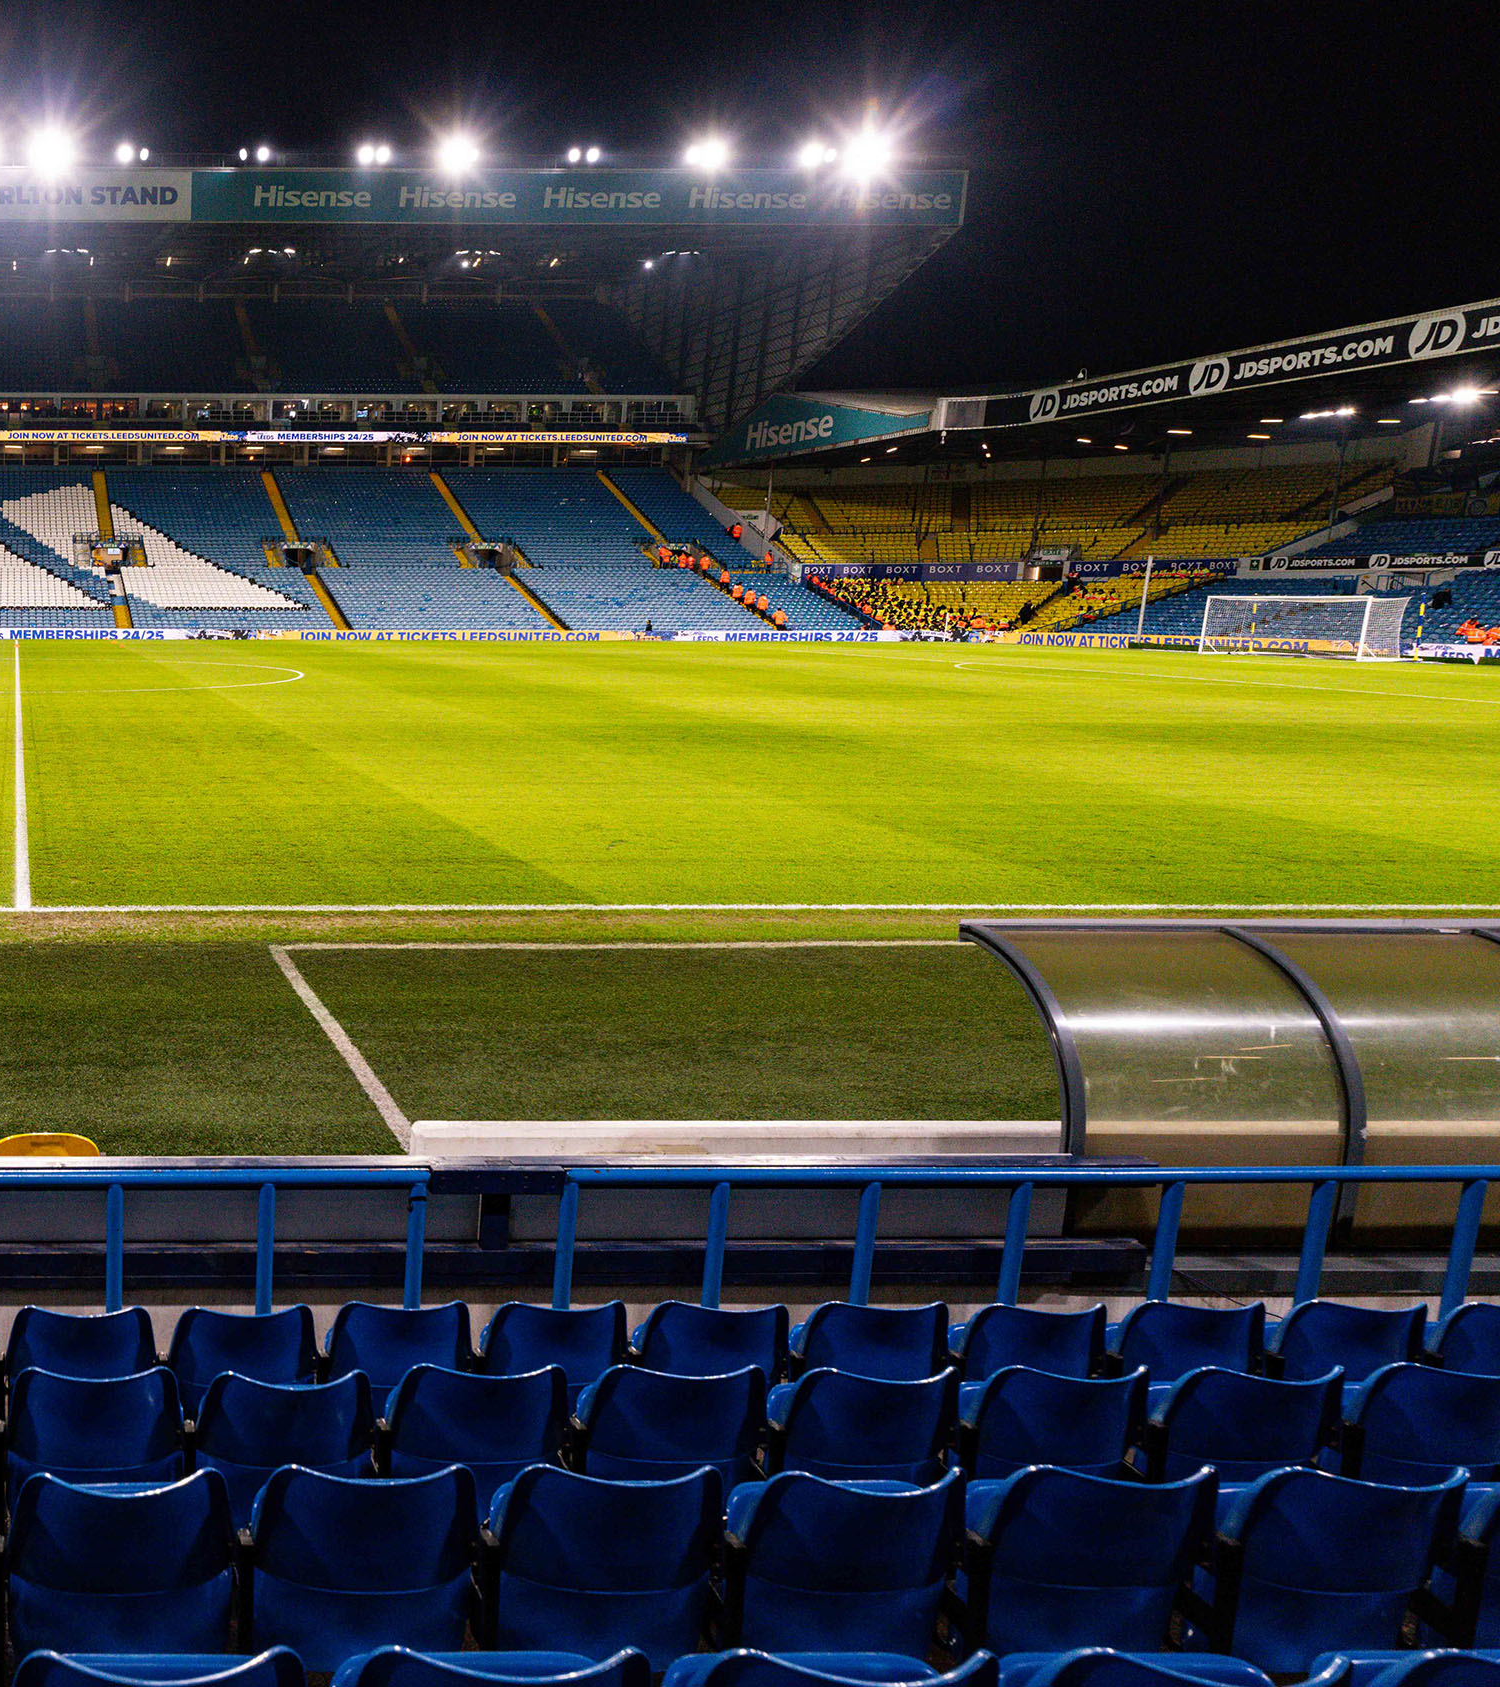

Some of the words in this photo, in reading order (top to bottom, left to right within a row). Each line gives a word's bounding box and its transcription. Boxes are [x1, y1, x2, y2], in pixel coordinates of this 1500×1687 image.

[91, 185, 179, 206] STAND
[253, 185, 372, 208] Hisense
[399, 186, 517, 209] Hisense
[544, 187, 661, 209] Hisense
[688, 187, 806, 209] Hisense
[1062, 374, 1178, 411] JDSPORTS.COM
[1233, 336, 1394, 381] JDSPORTS.COM
[8, 432, 30, 441] JOIN
[32, 432, 54, 440] NOW
[57, 432, 69, 440] AT
[70, 432, 200, 441] TICKETS.LEEDSUNITED.COM
[277, 432, 346, 441] MEMBERSHIPS
[347, 432, 375, 441] 24/25
[746, 413, 834, 450] Hisense
[457, 433, 478, 442] JOIN
[481, 433, 503, 442] NOW
[506, 433, 519, 442] AT
[520, 433, 648, 443] TICKETS.LEEDSUNITED.COM
[1075, 563, 1110, 572] BOXT
[1209, 561, 1239, 570] BOXT
[1290, 557, 1356, 567] JDSPORTS.COM
[1392, 555, 1468, 565] JDSPORTS.COM
[804, 566, 833, 575] BOXT
[843, 565, 873, 575] BOXT
[886, 565, 918, 575] BOXT
[929, 564, 962, 574] BOXT
[976, 564, 1011, 574] BOXT
[9, 630, 118, 640] MEMBERSHIPS
[122, 630, 165, 640] 24/25
[300, 632, 332, 641] JOIN
[336, 632, 372, 641] NOW
[376, 632, 394, 641] AT
[725, 632, 833, 642] MEMBERSHIPS
[836, 632, 879, 642] 24/25
[1017, 633, 1044, 646] JOIN
[1046, 633, 1077, 648] NOW
[1079, 634, 1096, 648] AT
